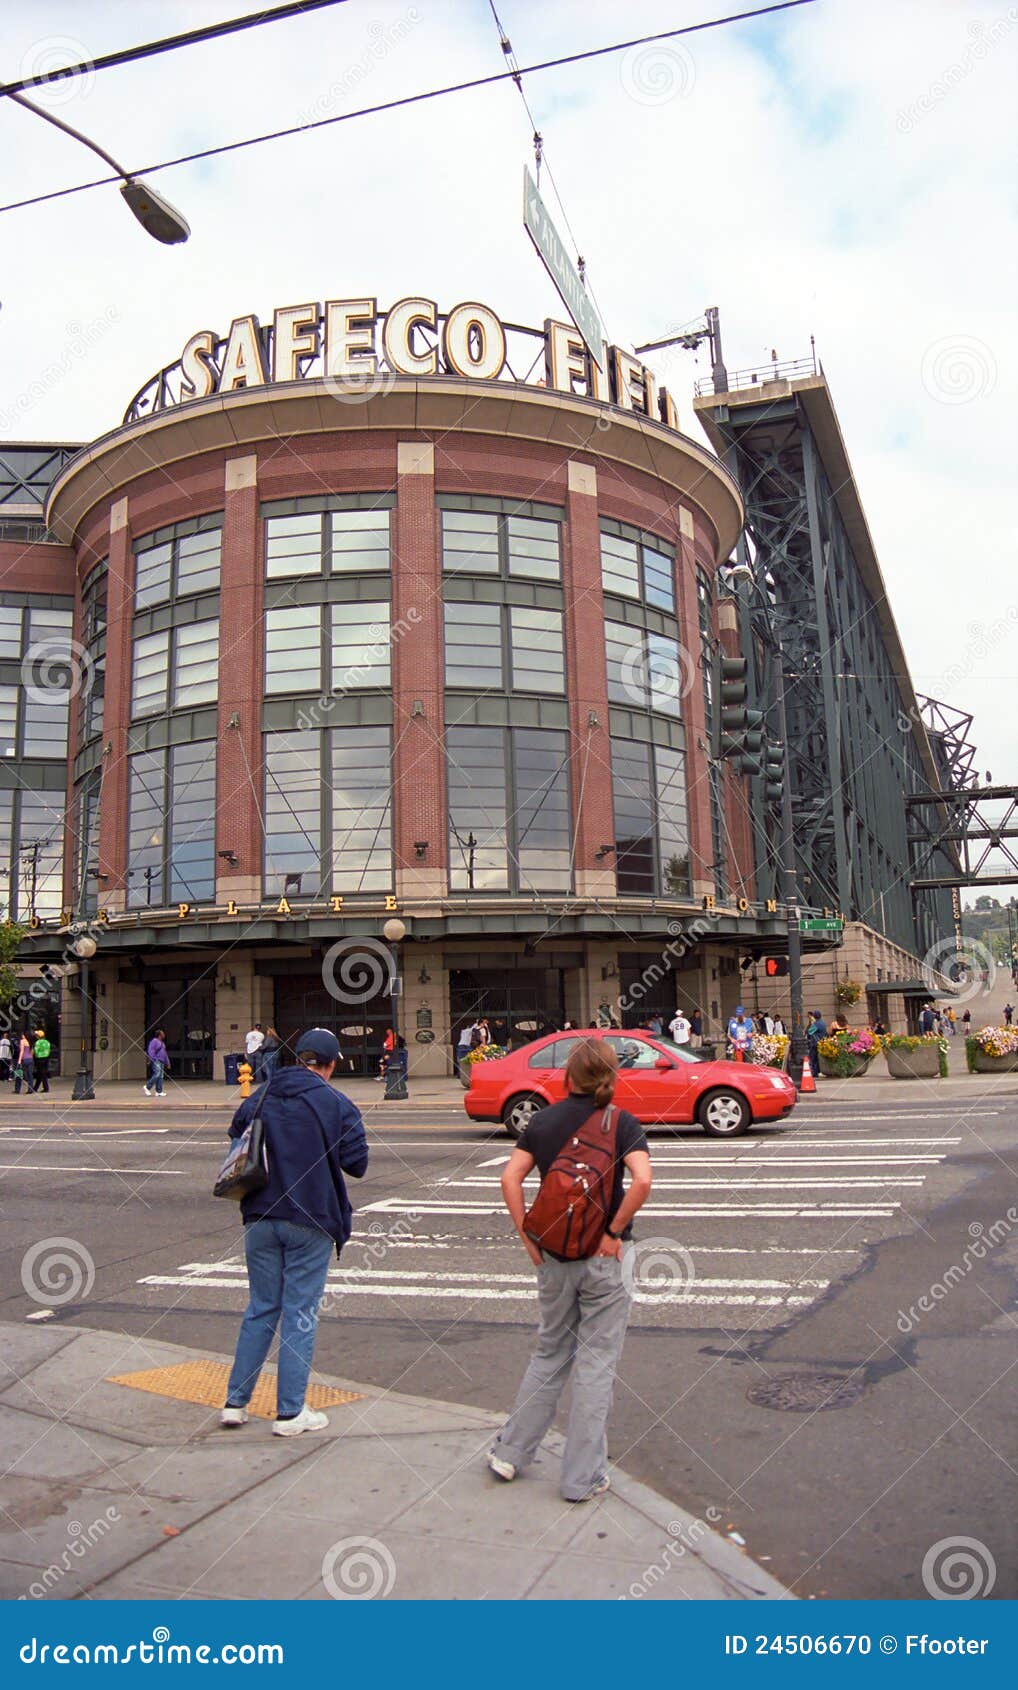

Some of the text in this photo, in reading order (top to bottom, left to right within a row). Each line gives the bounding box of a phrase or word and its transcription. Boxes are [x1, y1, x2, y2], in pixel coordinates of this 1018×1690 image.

[541, 218, 585, 322] ATLANTIC
[179, 297, 508, 398] SAFECO
[178, 896, 398, 918] PLATE
[704, 896, 777, 912] HOM
